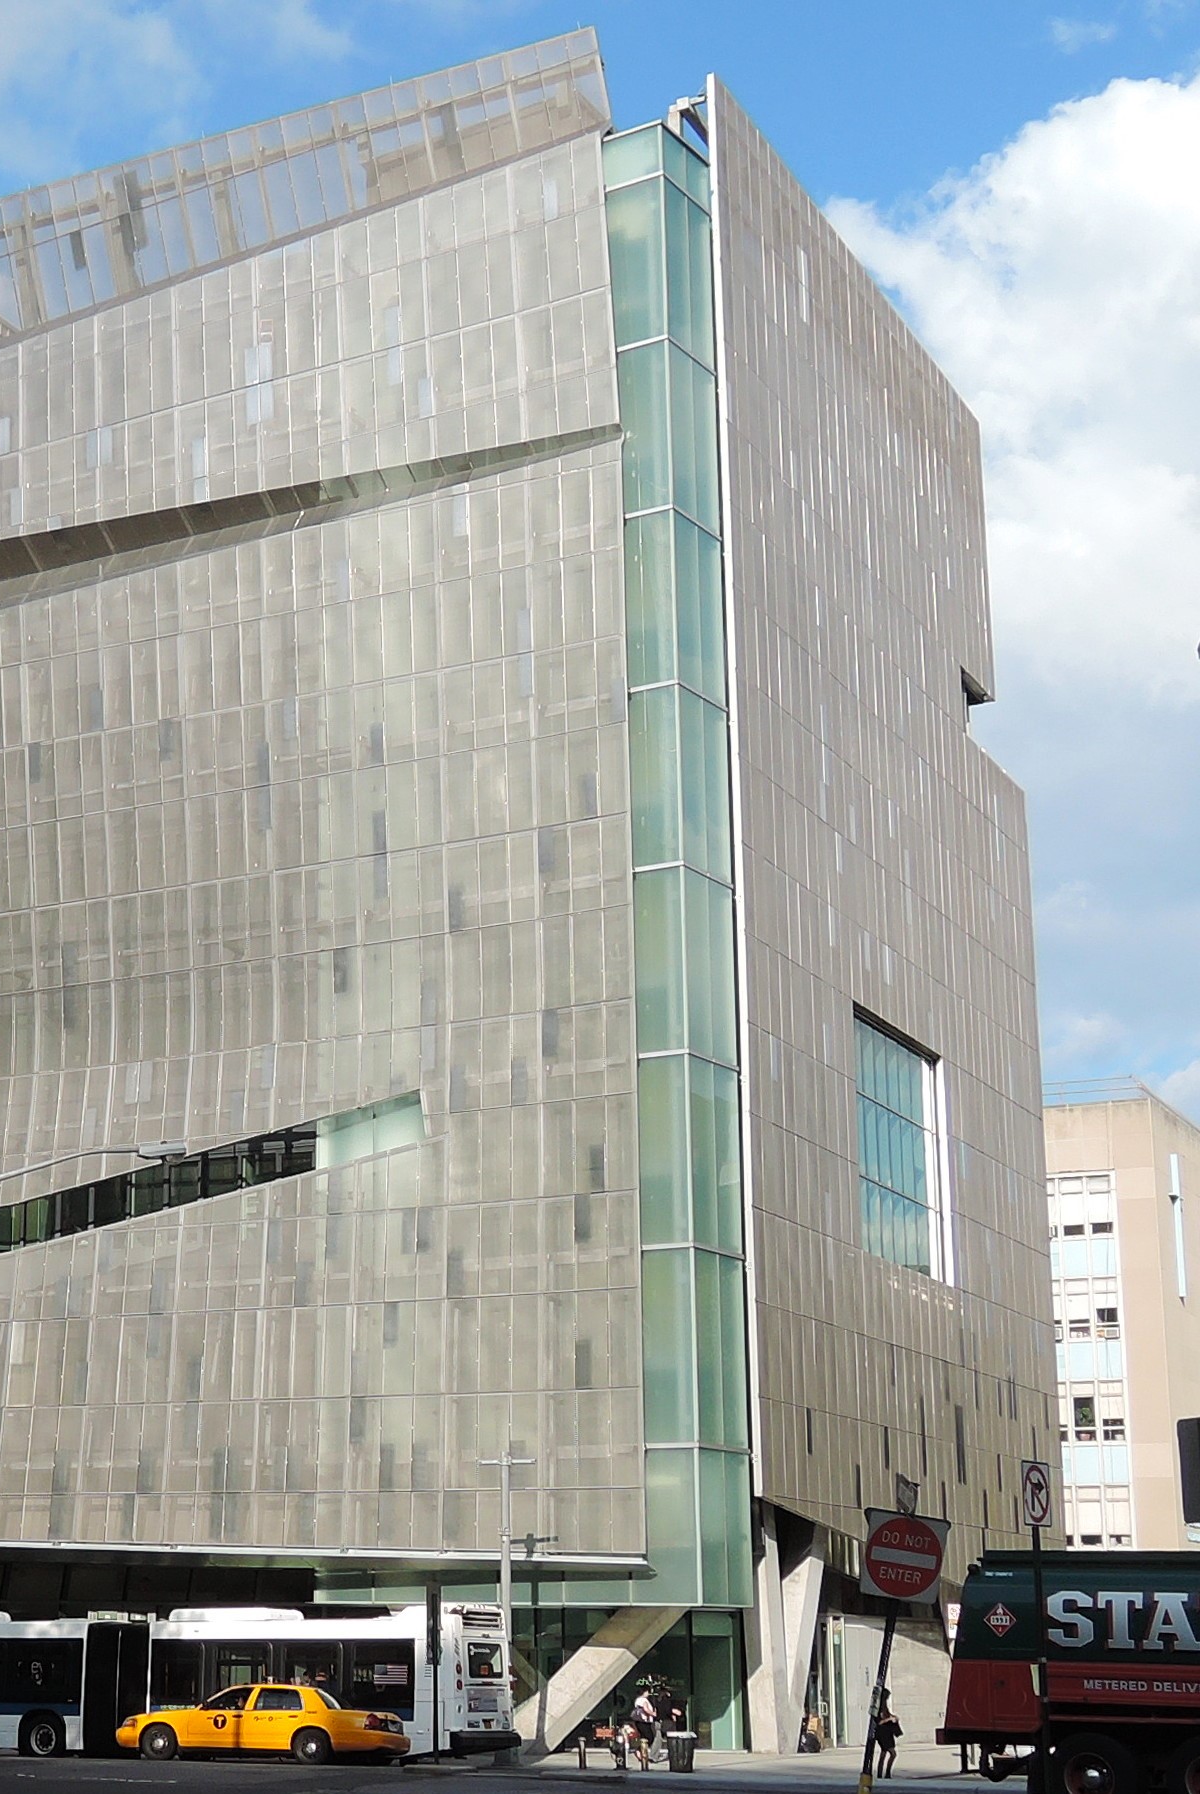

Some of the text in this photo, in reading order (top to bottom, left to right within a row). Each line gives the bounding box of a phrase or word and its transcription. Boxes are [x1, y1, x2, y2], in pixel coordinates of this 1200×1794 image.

[882, 1530, 931, 1549] DO NOT
[879, 1566, 922, 1585] ENTER
[1083, 1679, 1147, 1692] METERED
